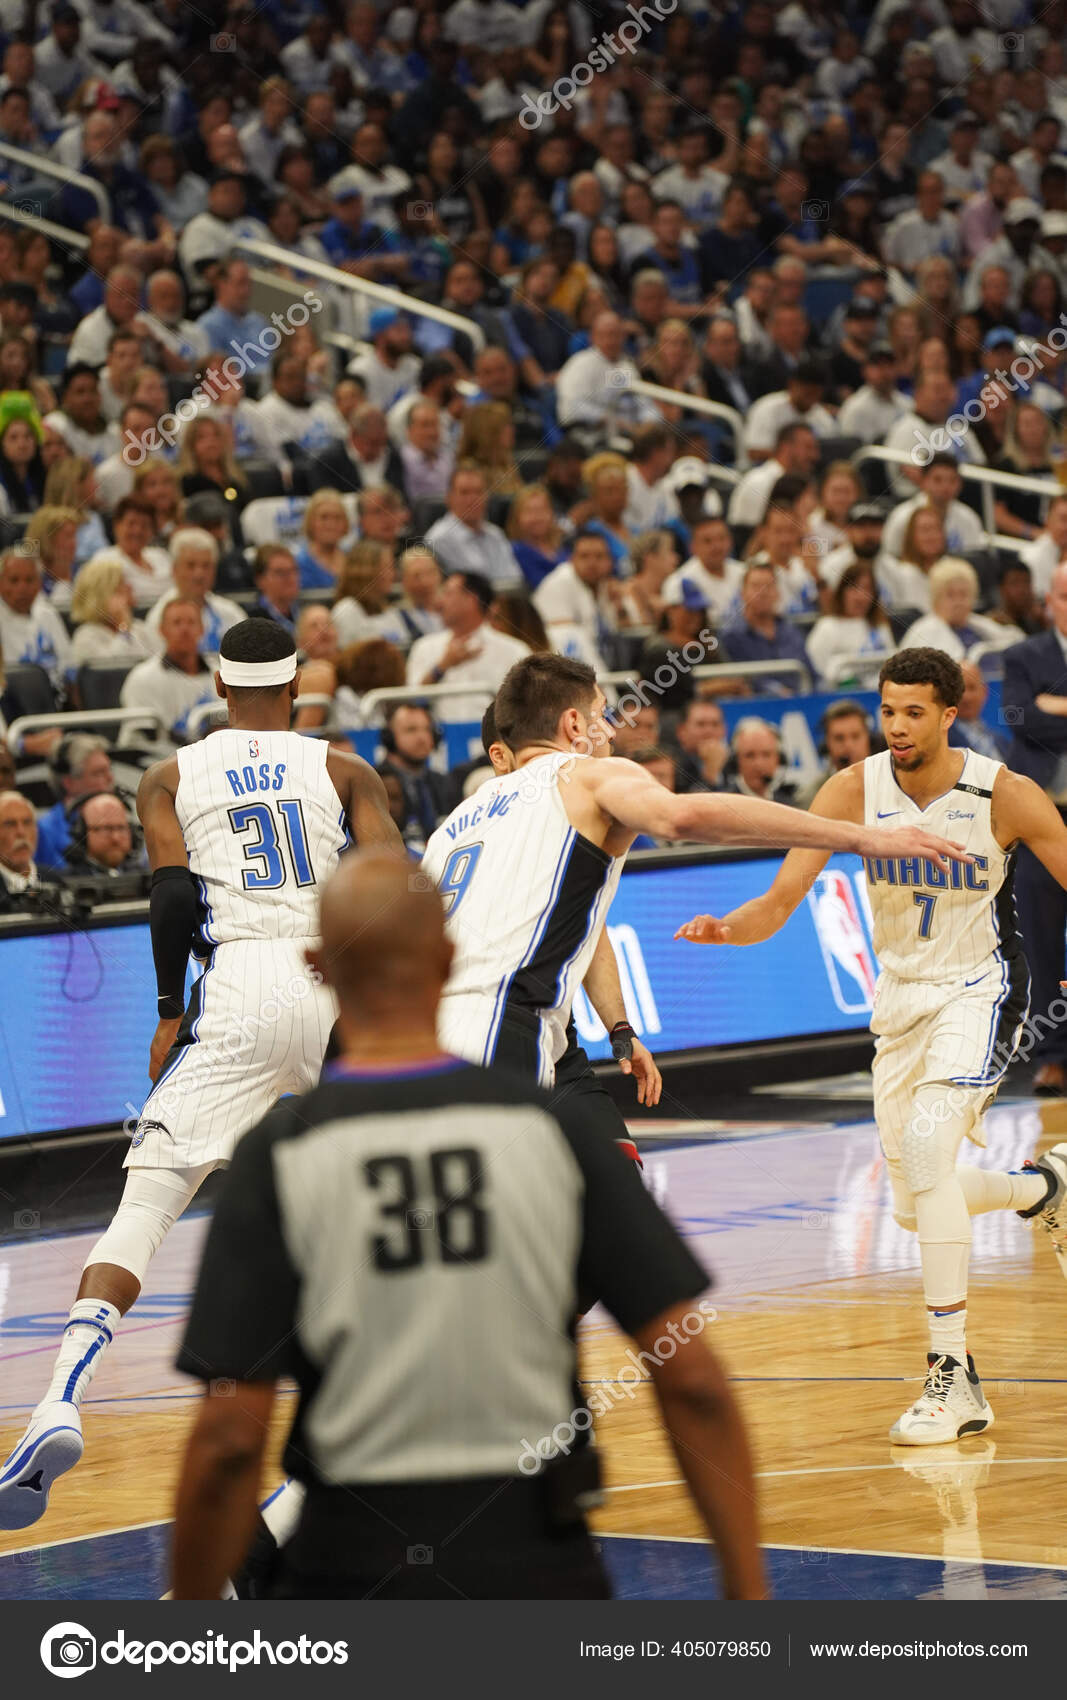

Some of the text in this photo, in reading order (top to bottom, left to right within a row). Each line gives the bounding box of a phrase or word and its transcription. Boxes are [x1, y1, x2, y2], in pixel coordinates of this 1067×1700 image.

[225, 763, 287, 797] ROSS
[227, 798, 317, 891] 31
[437, 840, 485, 920] 9
[913, 891, 938, 939] 7
[362, 1147, 491, 1273] 38
